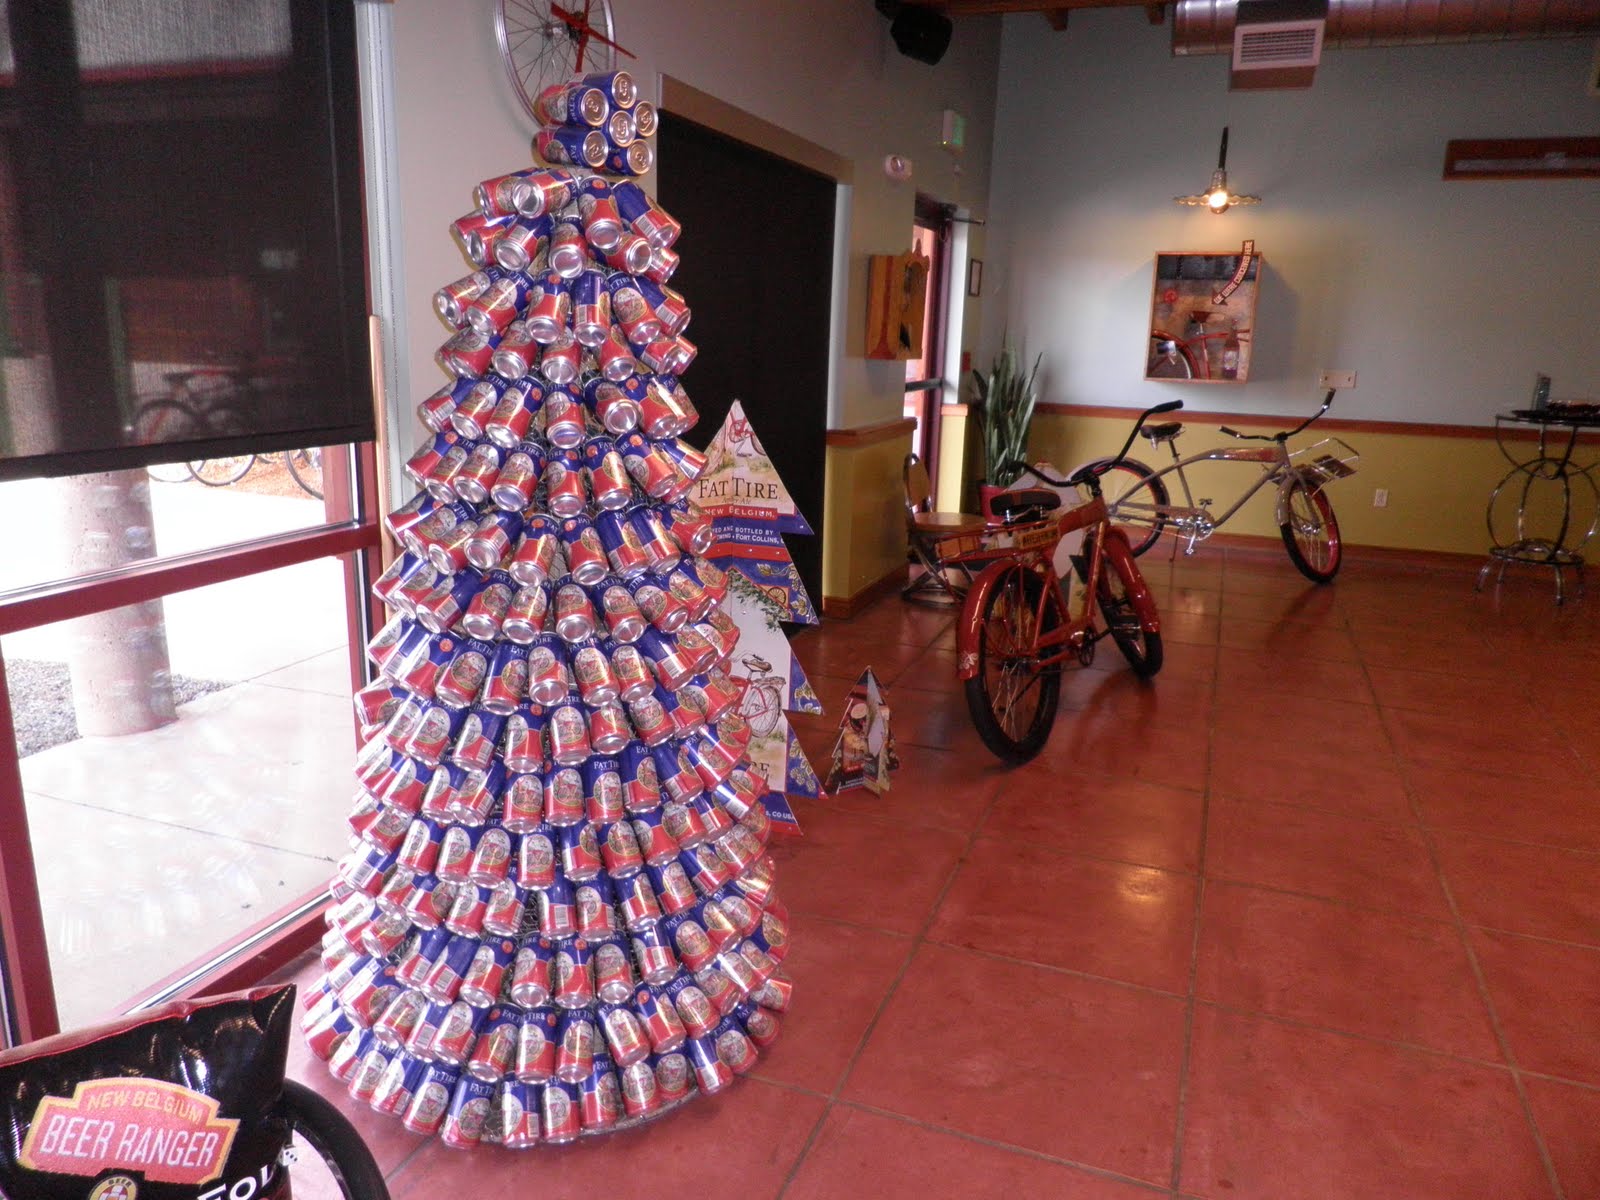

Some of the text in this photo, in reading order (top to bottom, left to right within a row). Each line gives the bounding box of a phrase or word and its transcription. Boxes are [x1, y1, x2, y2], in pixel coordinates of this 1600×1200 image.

[698, 476, 778, 500] FAT TIRE
[704, 508, 724, 516] NEW
[735, 527, 763, 535] BOTTLED
[735, 533, 750, 541] FORT
[636, 746, 649, 754] FAT
[594, 761, 608, 769] FAT
[665, 983, 679, 995] FAT
[502, 1009, 515, 1019] FAT
[568, 1010, 581, 1018] FAT
[440, 1072, 457, 1083] TIRE
[469, 1083, 484, 1092] FAT
[87, 1090, 204, 1124] NEW BELGIUM
[39, 1115, 220, 1168] BEER RANGER
[108, 1177, 132, 1188] BEER
